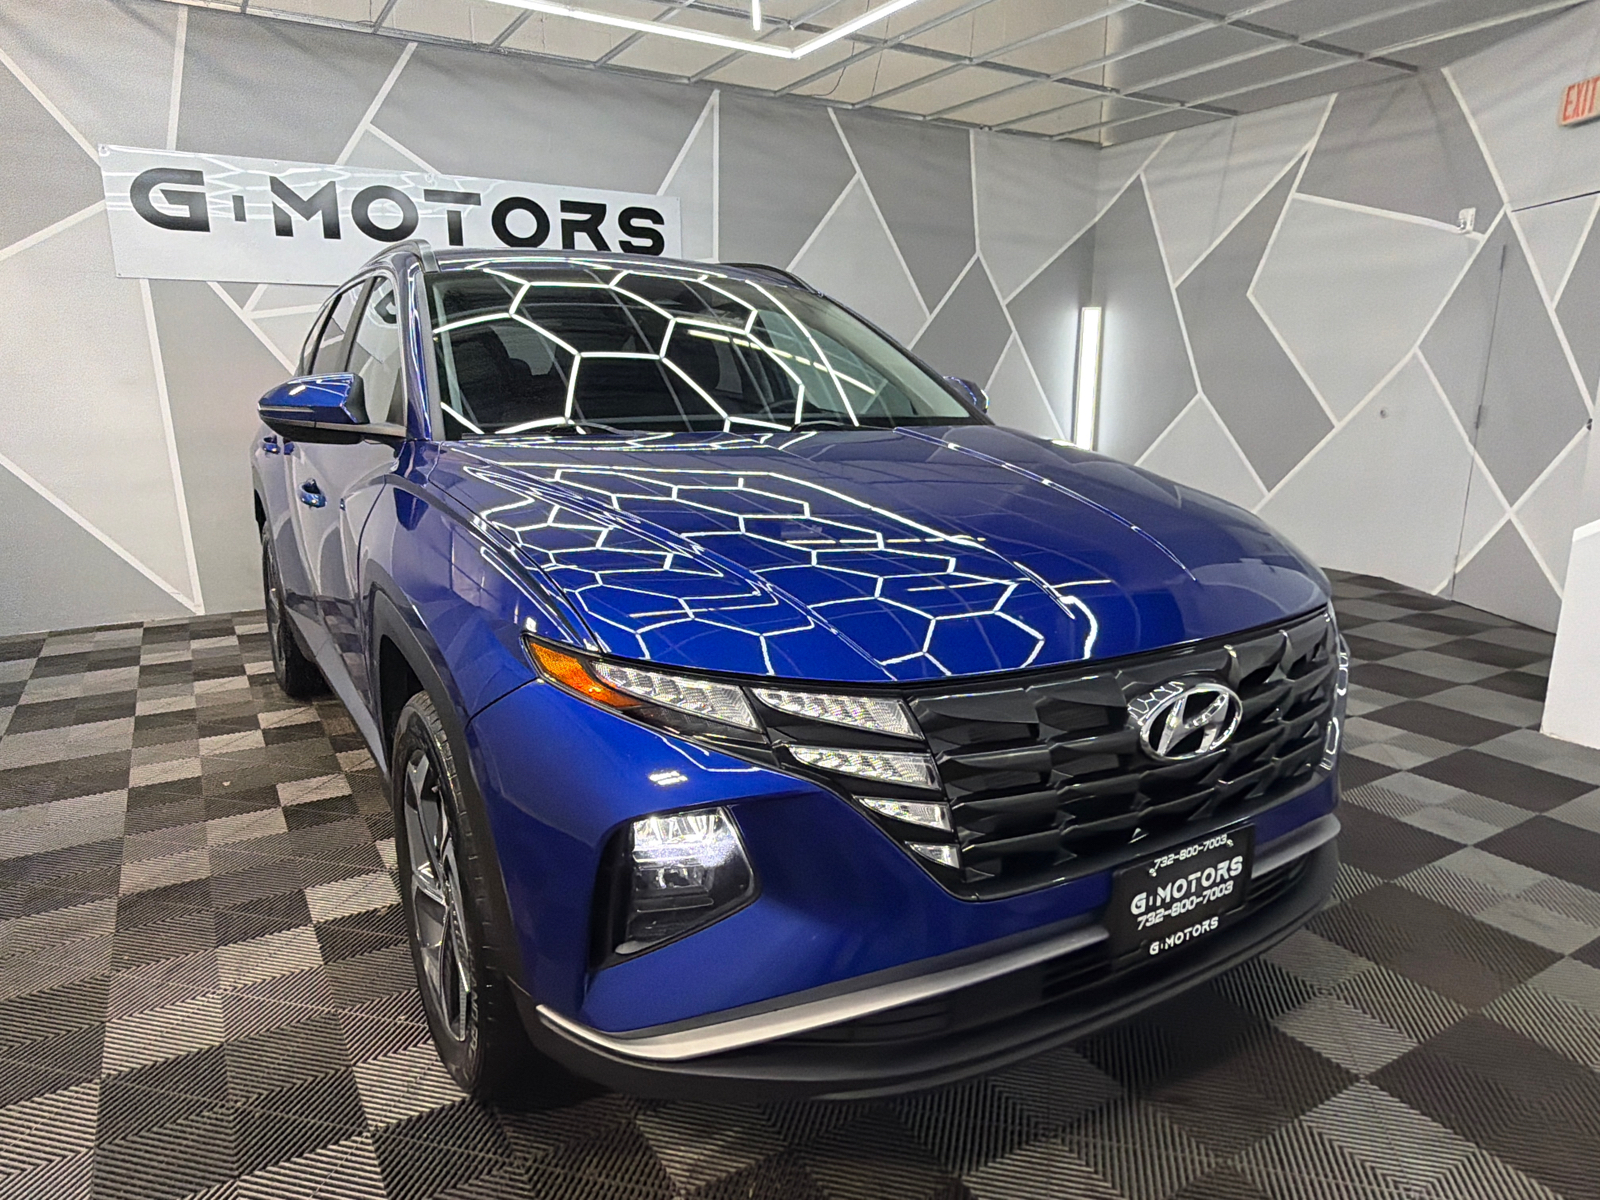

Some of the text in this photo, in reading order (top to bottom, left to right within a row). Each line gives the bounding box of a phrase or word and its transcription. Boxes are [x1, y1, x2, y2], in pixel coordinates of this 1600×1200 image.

[1563, 76, 1600, 121] EXIT
[1153, 834, 1228, 869] 732-800-7003
[1137, 880, 1234, 930] 732-800-7003
